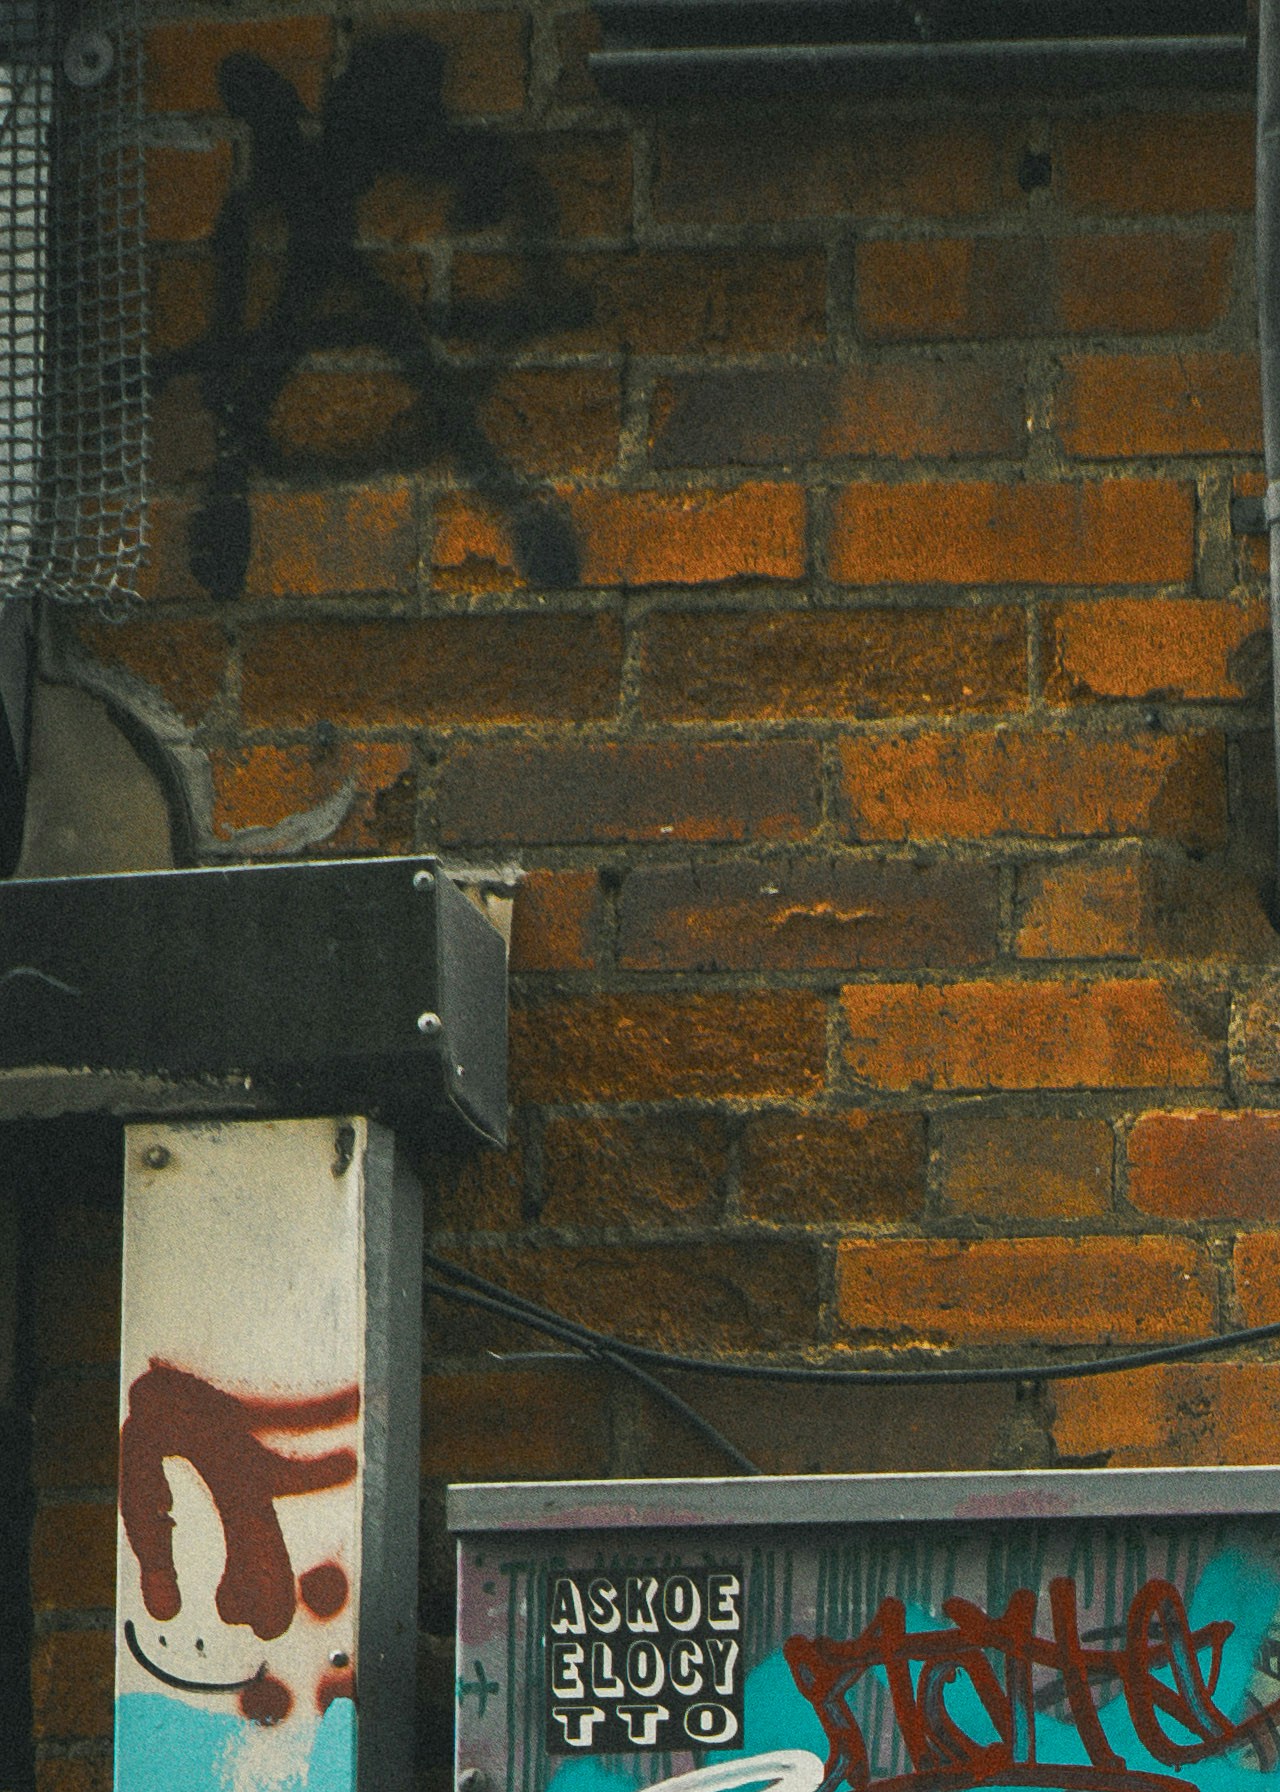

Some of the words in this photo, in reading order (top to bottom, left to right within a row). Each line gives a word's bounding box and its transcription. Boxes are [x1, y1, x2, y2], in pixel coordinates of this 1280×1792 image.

[551, 1574, 740, 1635] ASKOE
[552, 1638, 739, 1699] ELOCY
[552, 1702, 738, 1747] TTO
